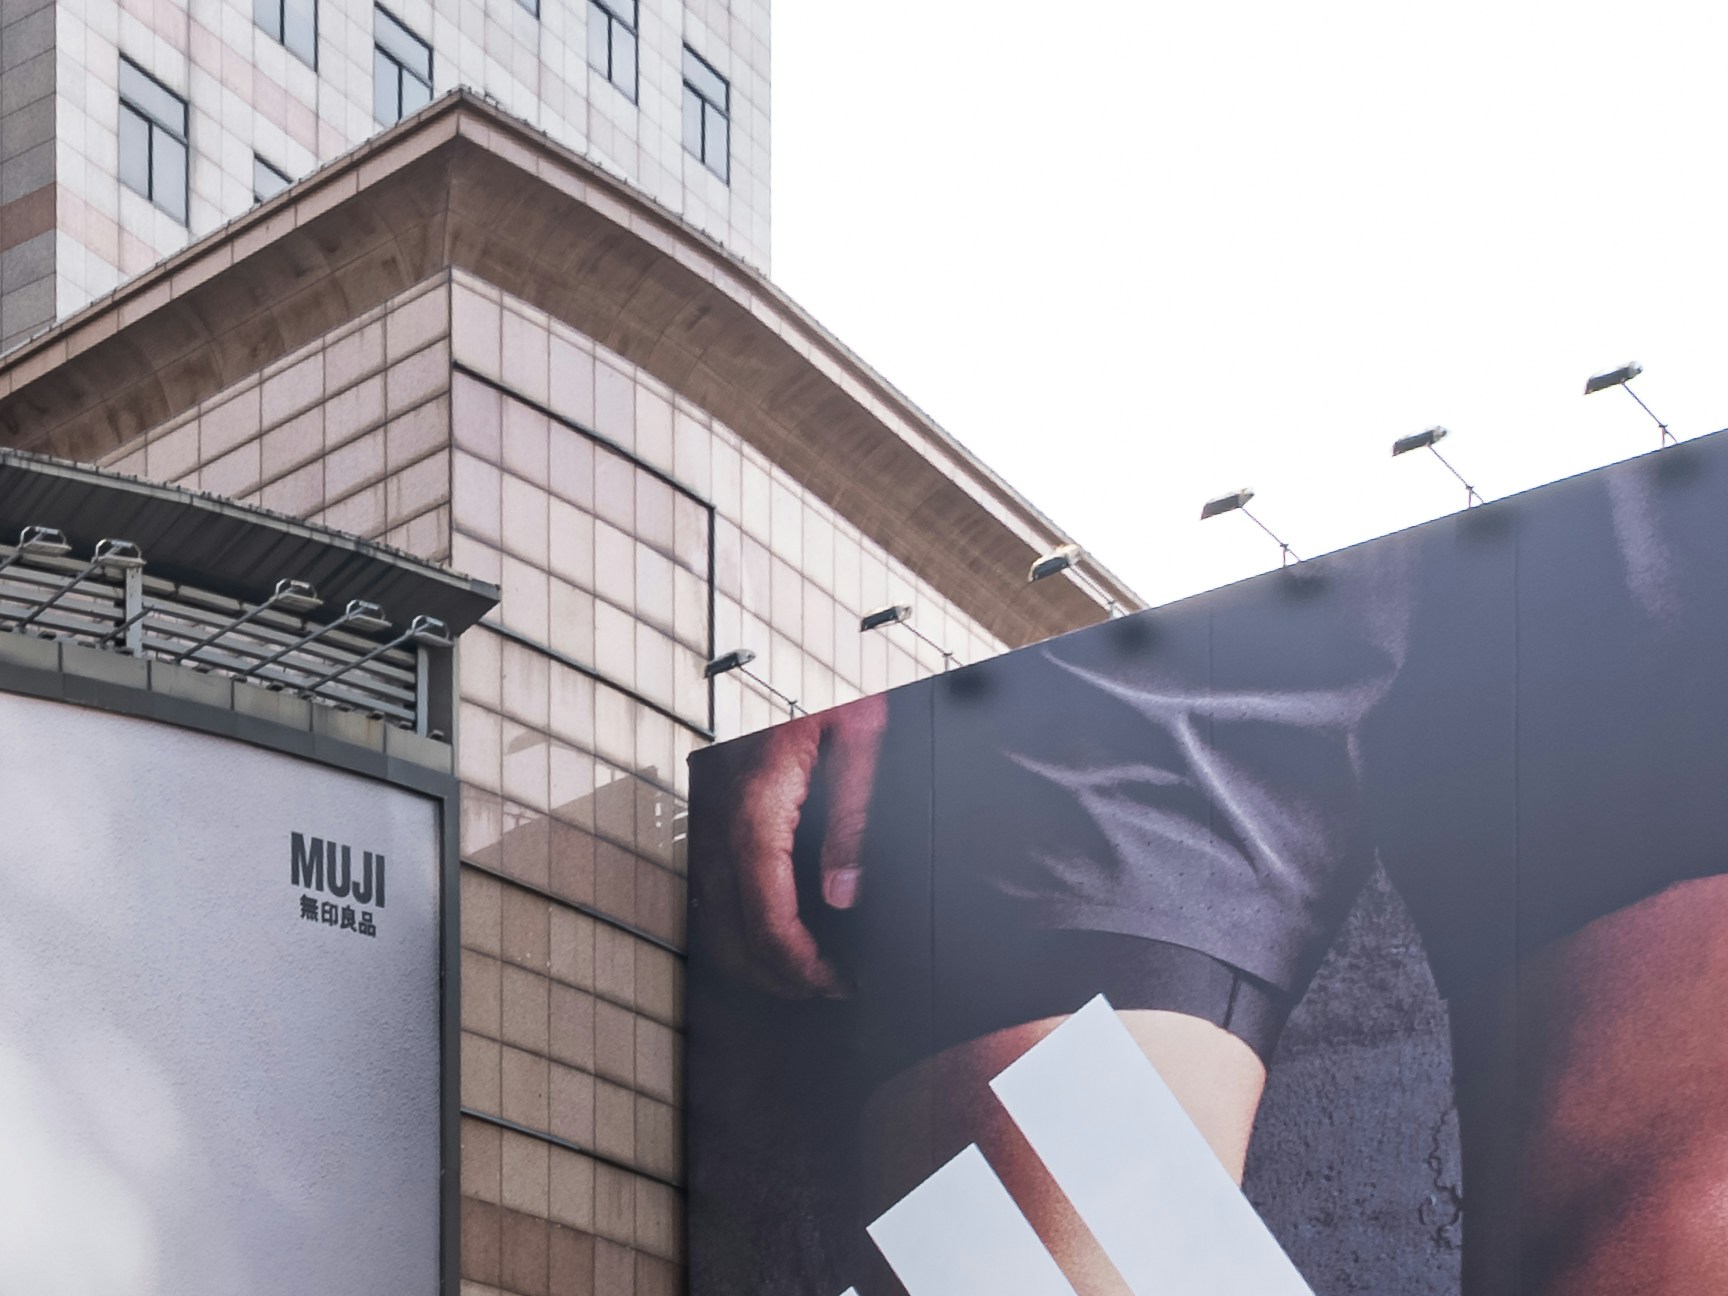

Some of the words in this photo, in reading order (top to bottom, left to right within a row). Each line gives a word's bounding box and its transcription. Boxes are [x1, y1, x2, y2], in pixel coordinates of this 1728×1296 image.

[291, 831, 385, 908] MUJI
[299, 894, 377, 938] 無印良品
